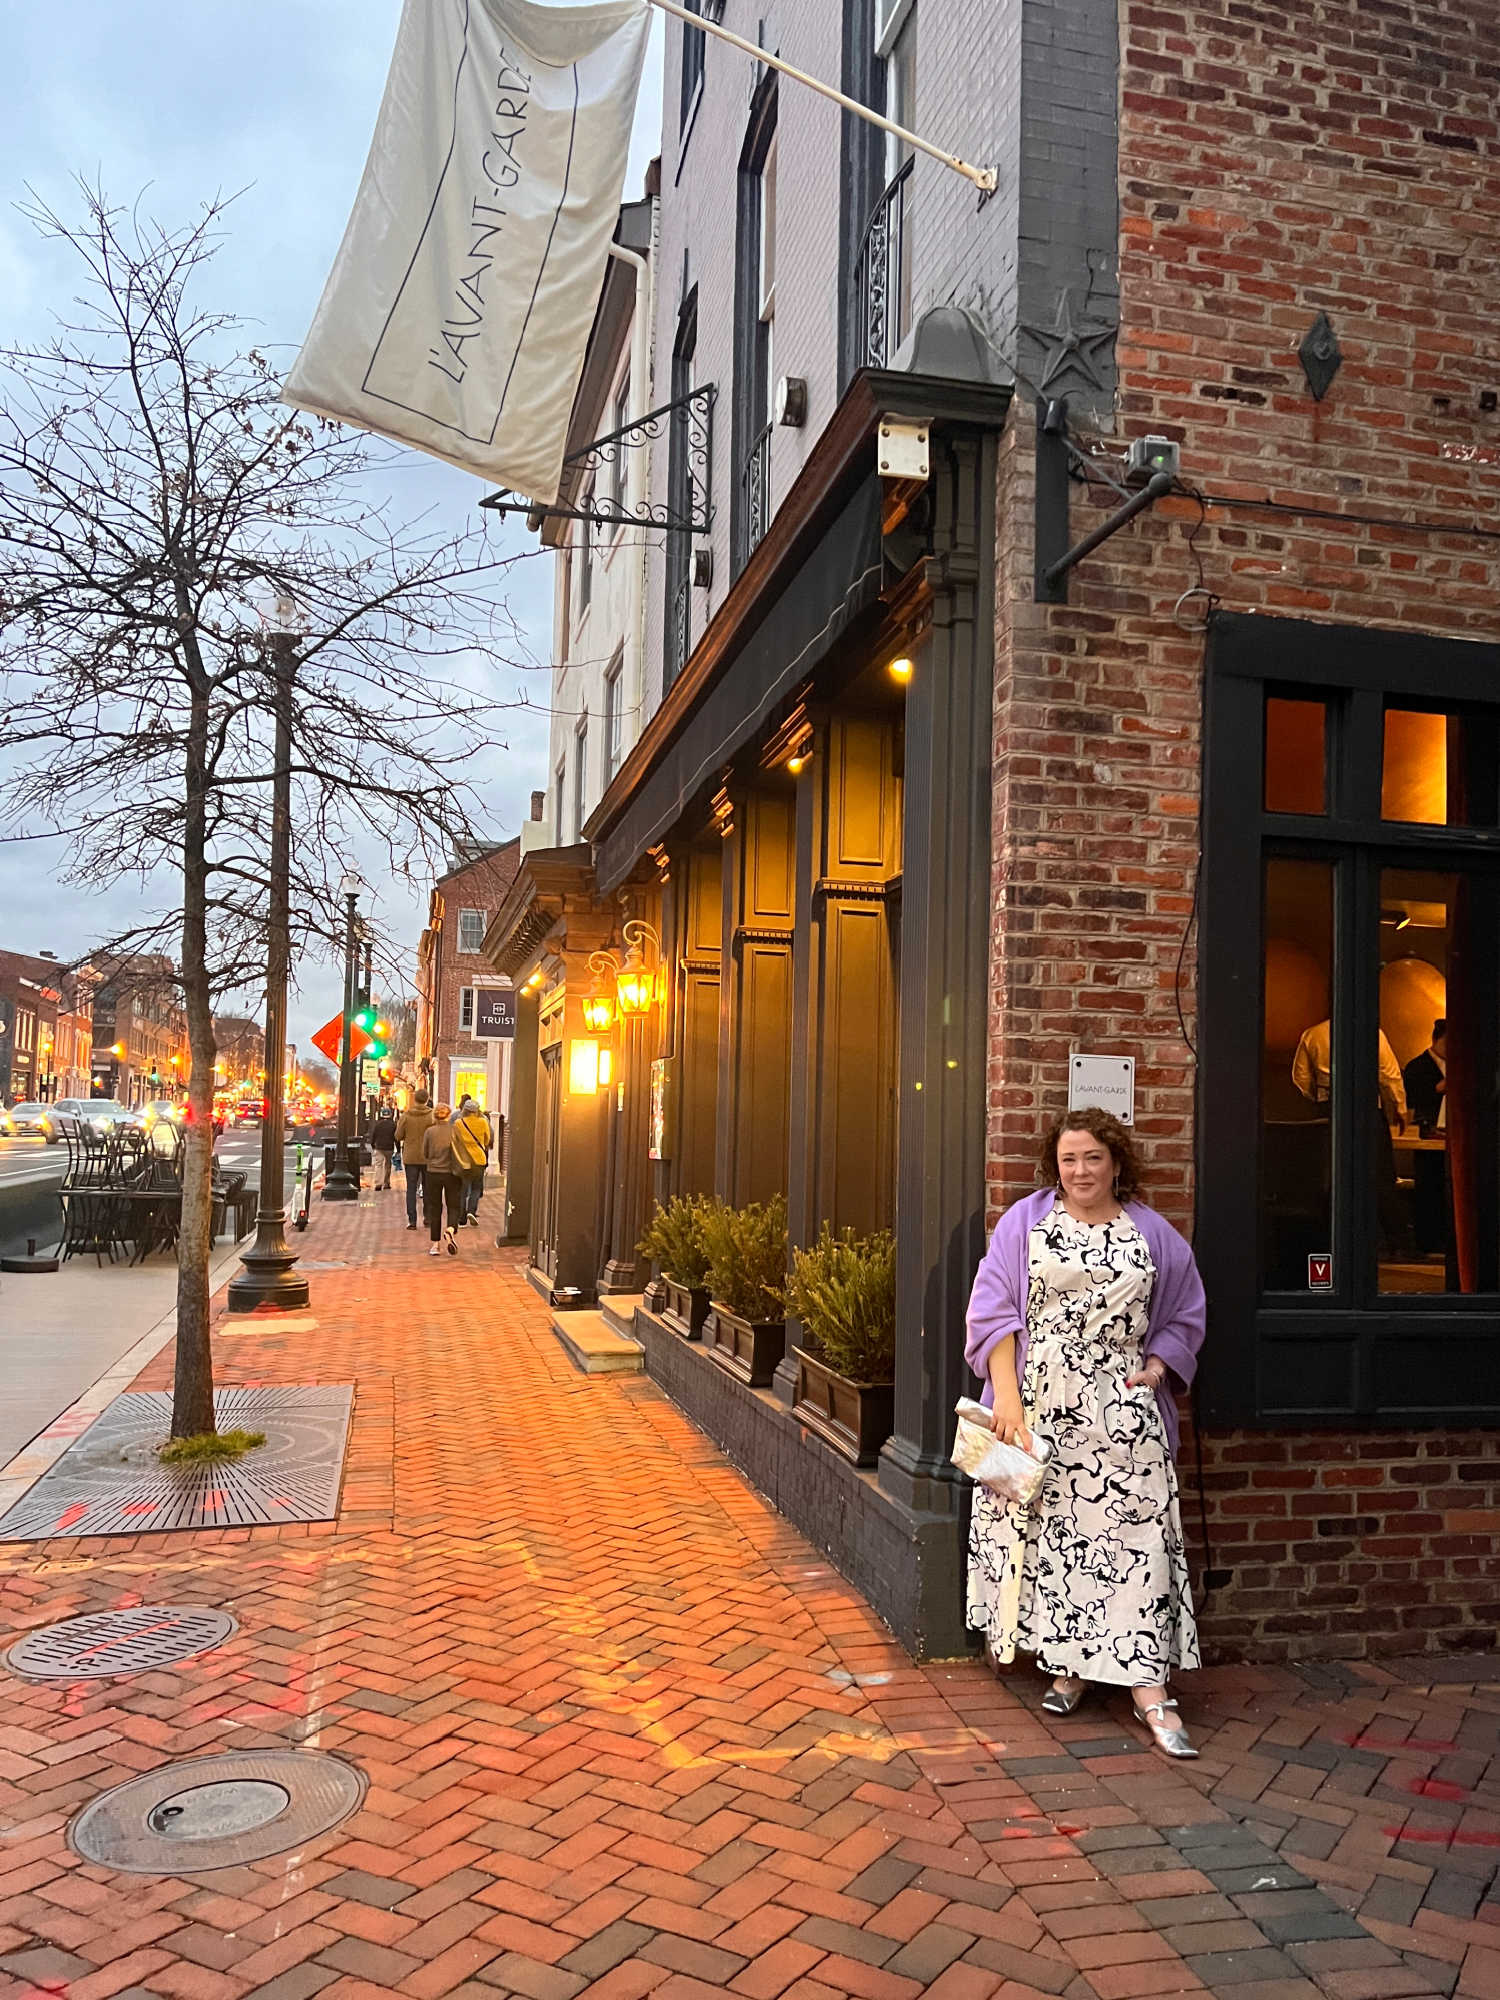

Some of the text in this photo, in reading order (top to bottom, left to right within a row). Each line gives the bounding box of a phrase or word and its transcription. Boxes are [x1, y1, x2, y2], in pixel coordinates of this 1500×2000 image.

[428, 47, 532, 384] L'AVANT-GARDE
[481, 1016, 515, 1025] TRUIST
[1315, 1263, 1326, 1276] V
